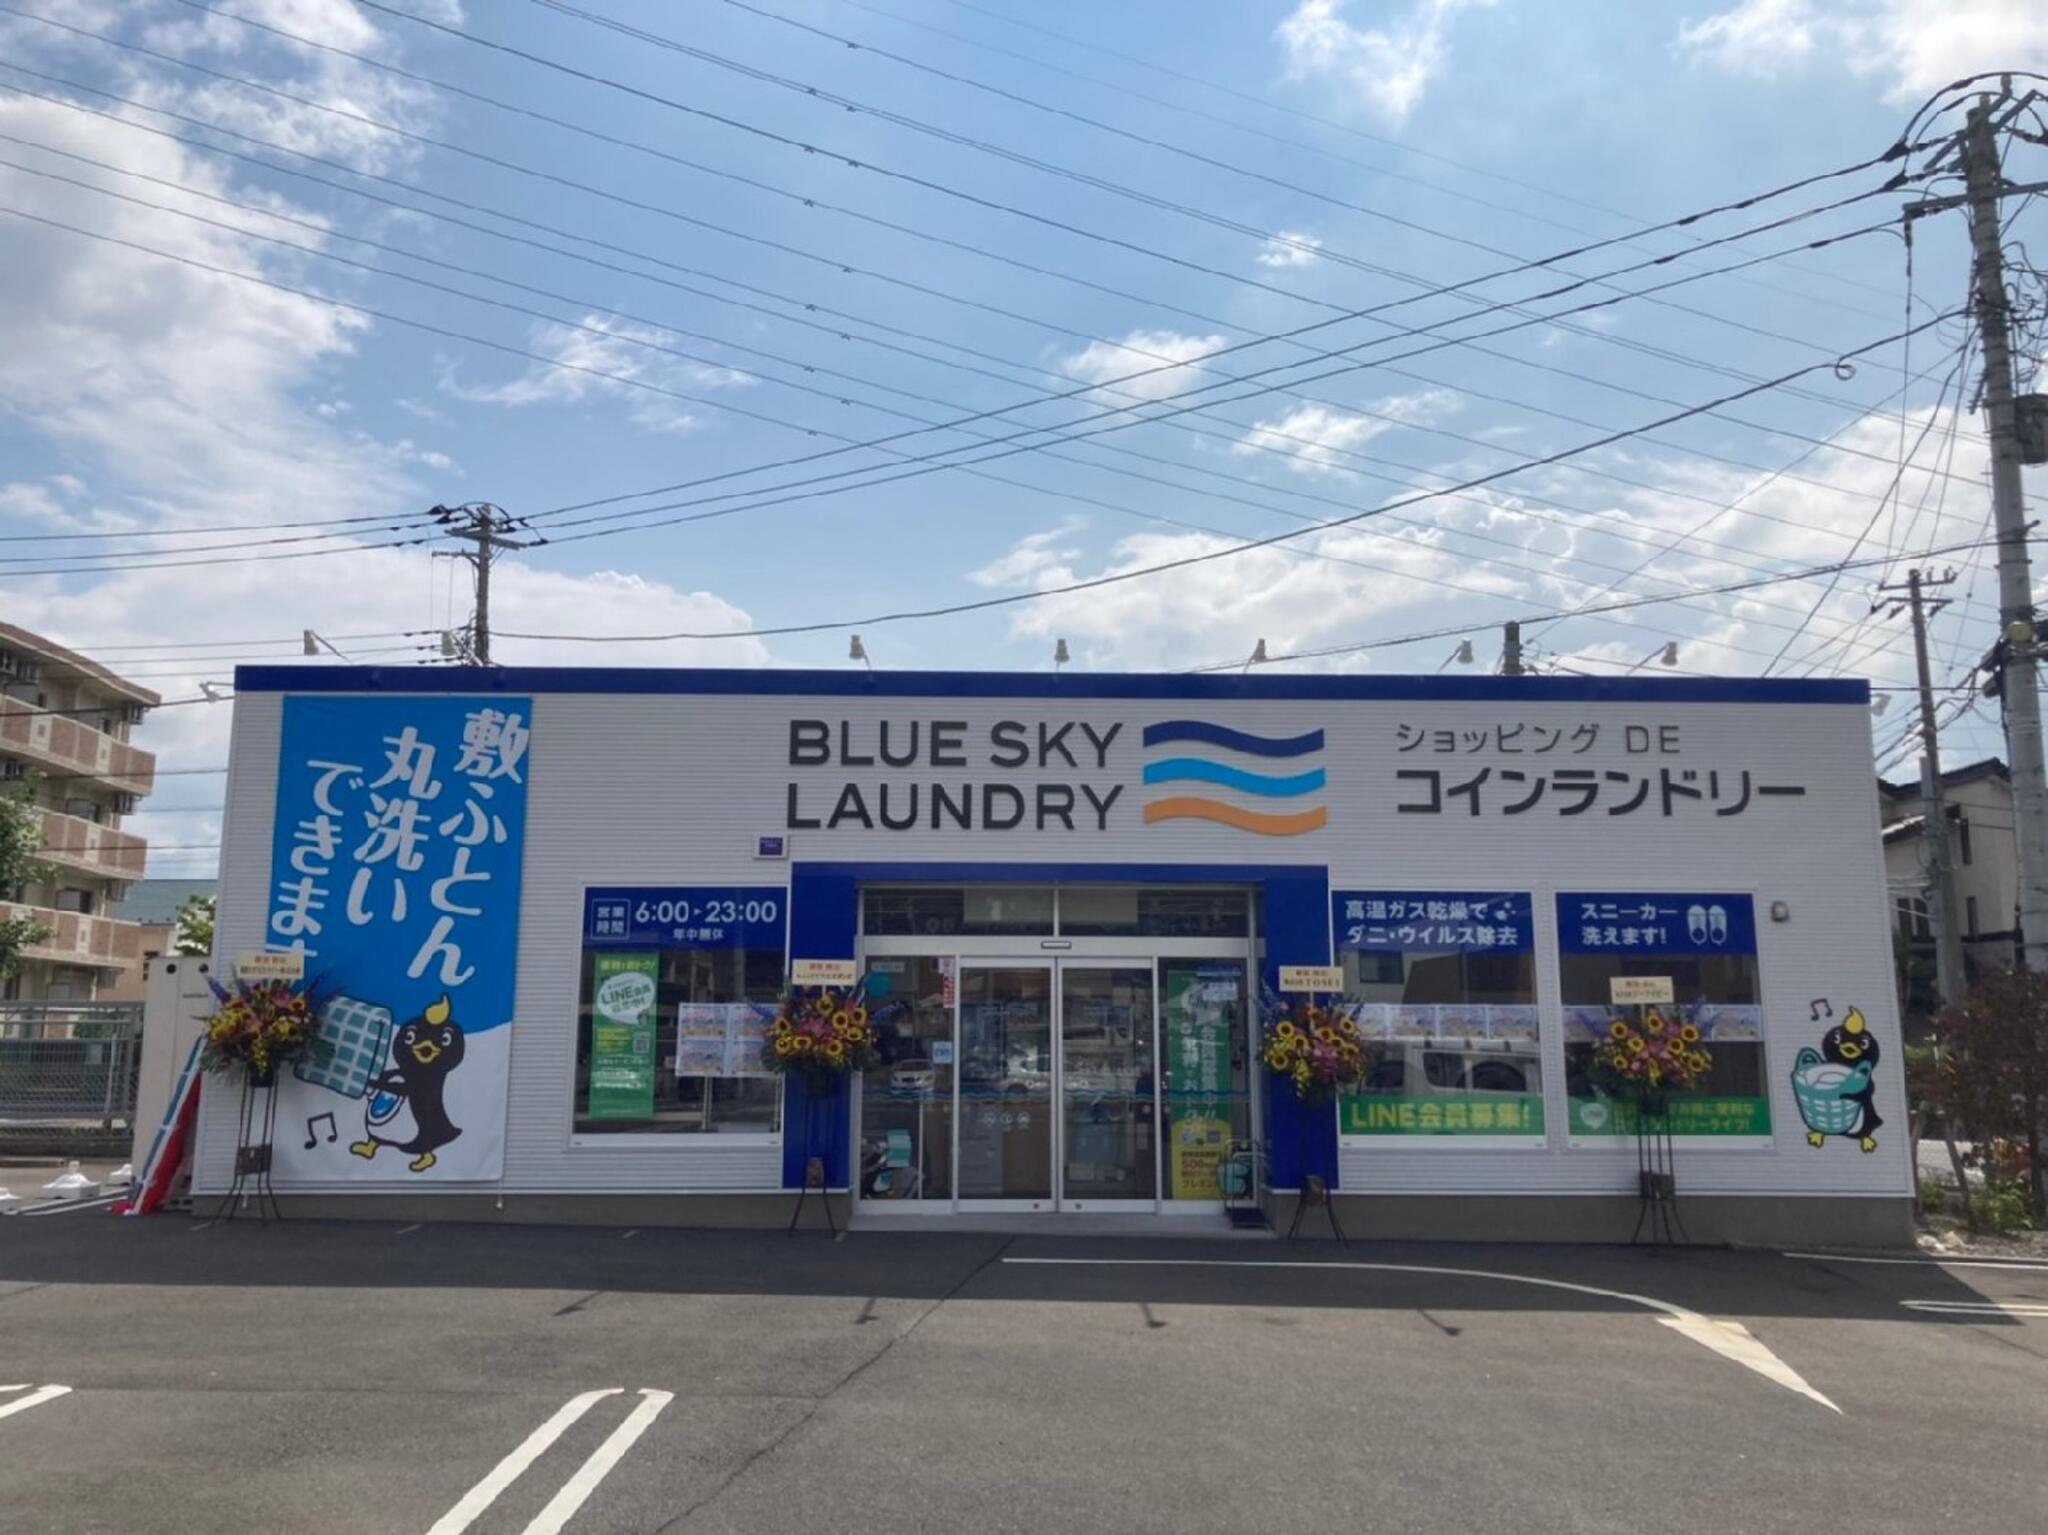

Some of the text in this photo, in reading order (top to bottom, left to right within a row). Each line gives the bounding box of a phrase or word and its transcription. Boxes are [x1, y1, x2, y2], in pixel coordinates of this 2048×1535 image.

[788, 719, 1124, 769] BLUE SKY
[1396, 722, 1681, 754] ショッピング DE
[786, 783, 1125, 831] LAUNDRY
[1395, 766, 1807, 817] コインランドリー
[346, 725, 443, 926] 丸洗い
[406, 707, 530, 987] 敷ふとん
[634, 900, 778, 924] 6:00 23:00
[1344, 899, 1489, 920] 高温ガス乾燥で
[1580, 902, 1680, 921] スニーカー
[1346, 924, 1519, 946] ダニ・ウイルス除去
[1350, 1101, 1532, 1129] LINE会員募集!
